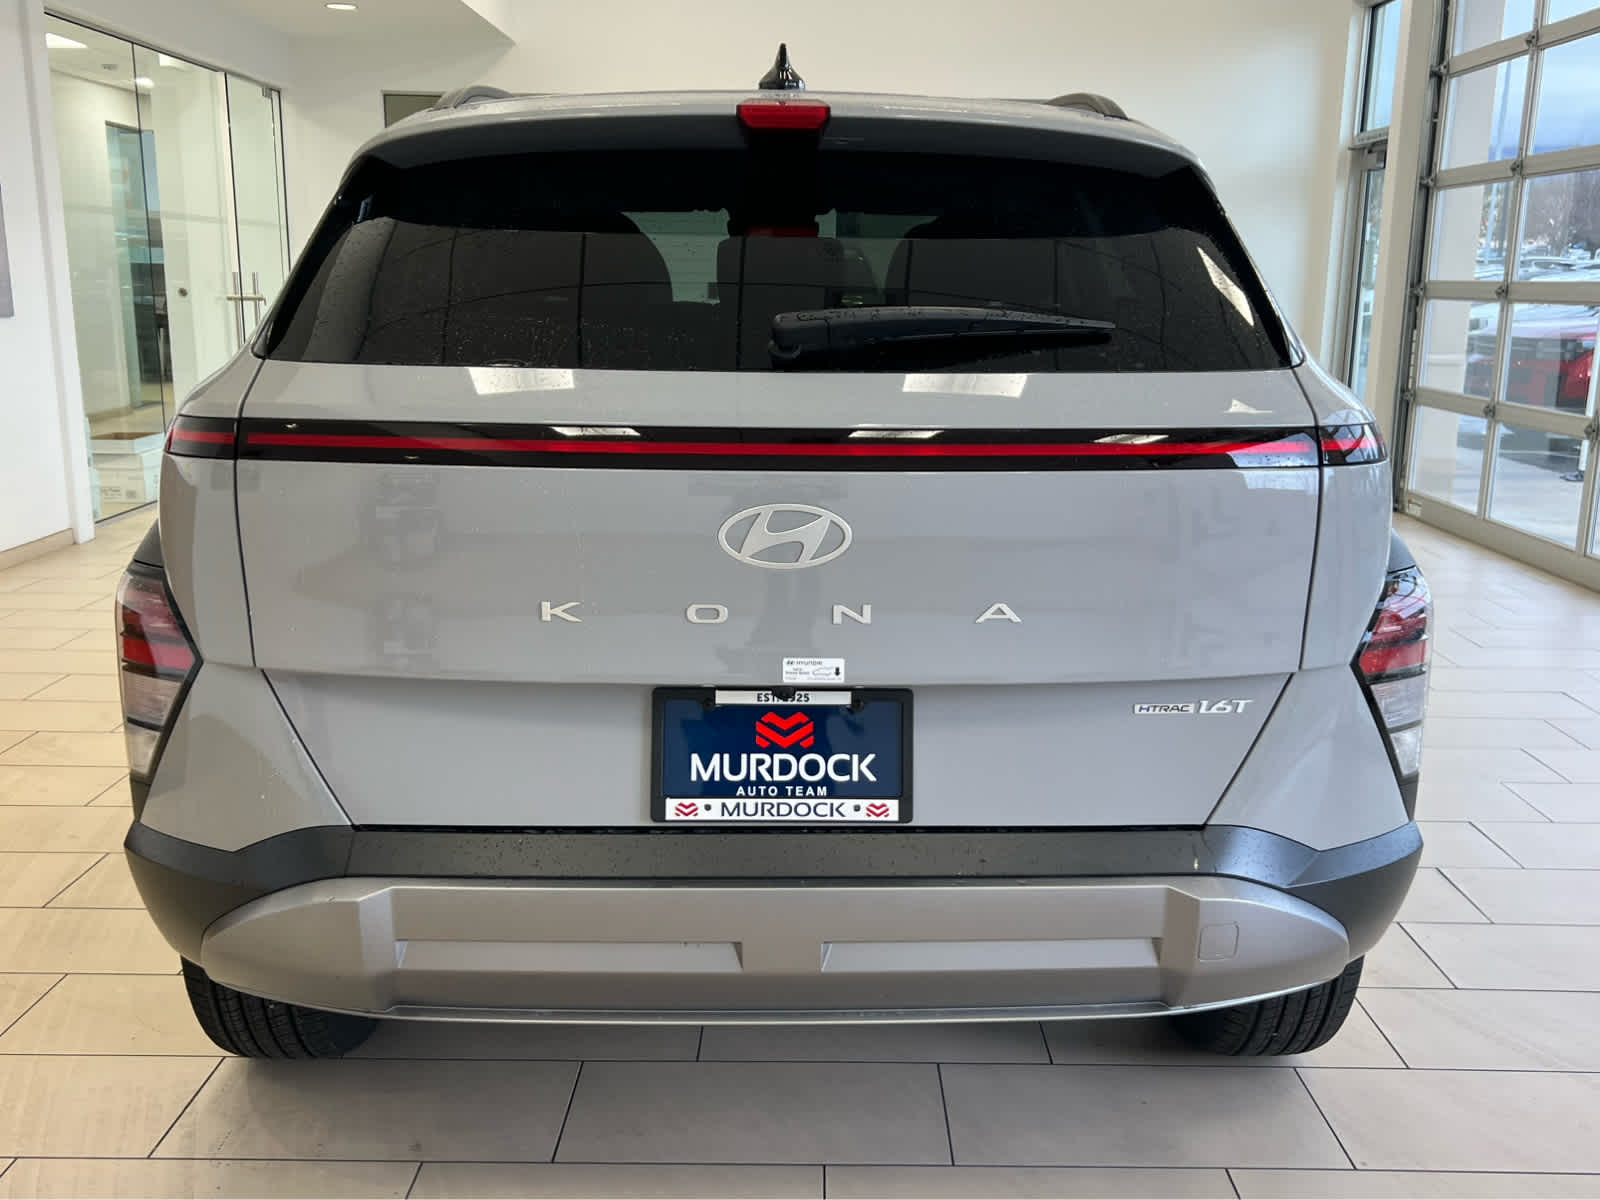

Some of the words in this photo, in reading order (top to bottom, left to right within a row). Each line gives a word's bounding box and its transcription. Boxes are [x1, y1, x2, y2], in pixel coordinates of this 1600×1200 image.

[540, 601, 1022, 624] KONA
[1138, 704, 1191, 713] HTRAC
[690, 753, 877, 782] MURDOCK
[736, 786, 779, 797] AUTO
[785, 786, 828, 797] TEAM
[720, 801, 846, 818] MURDOCK
